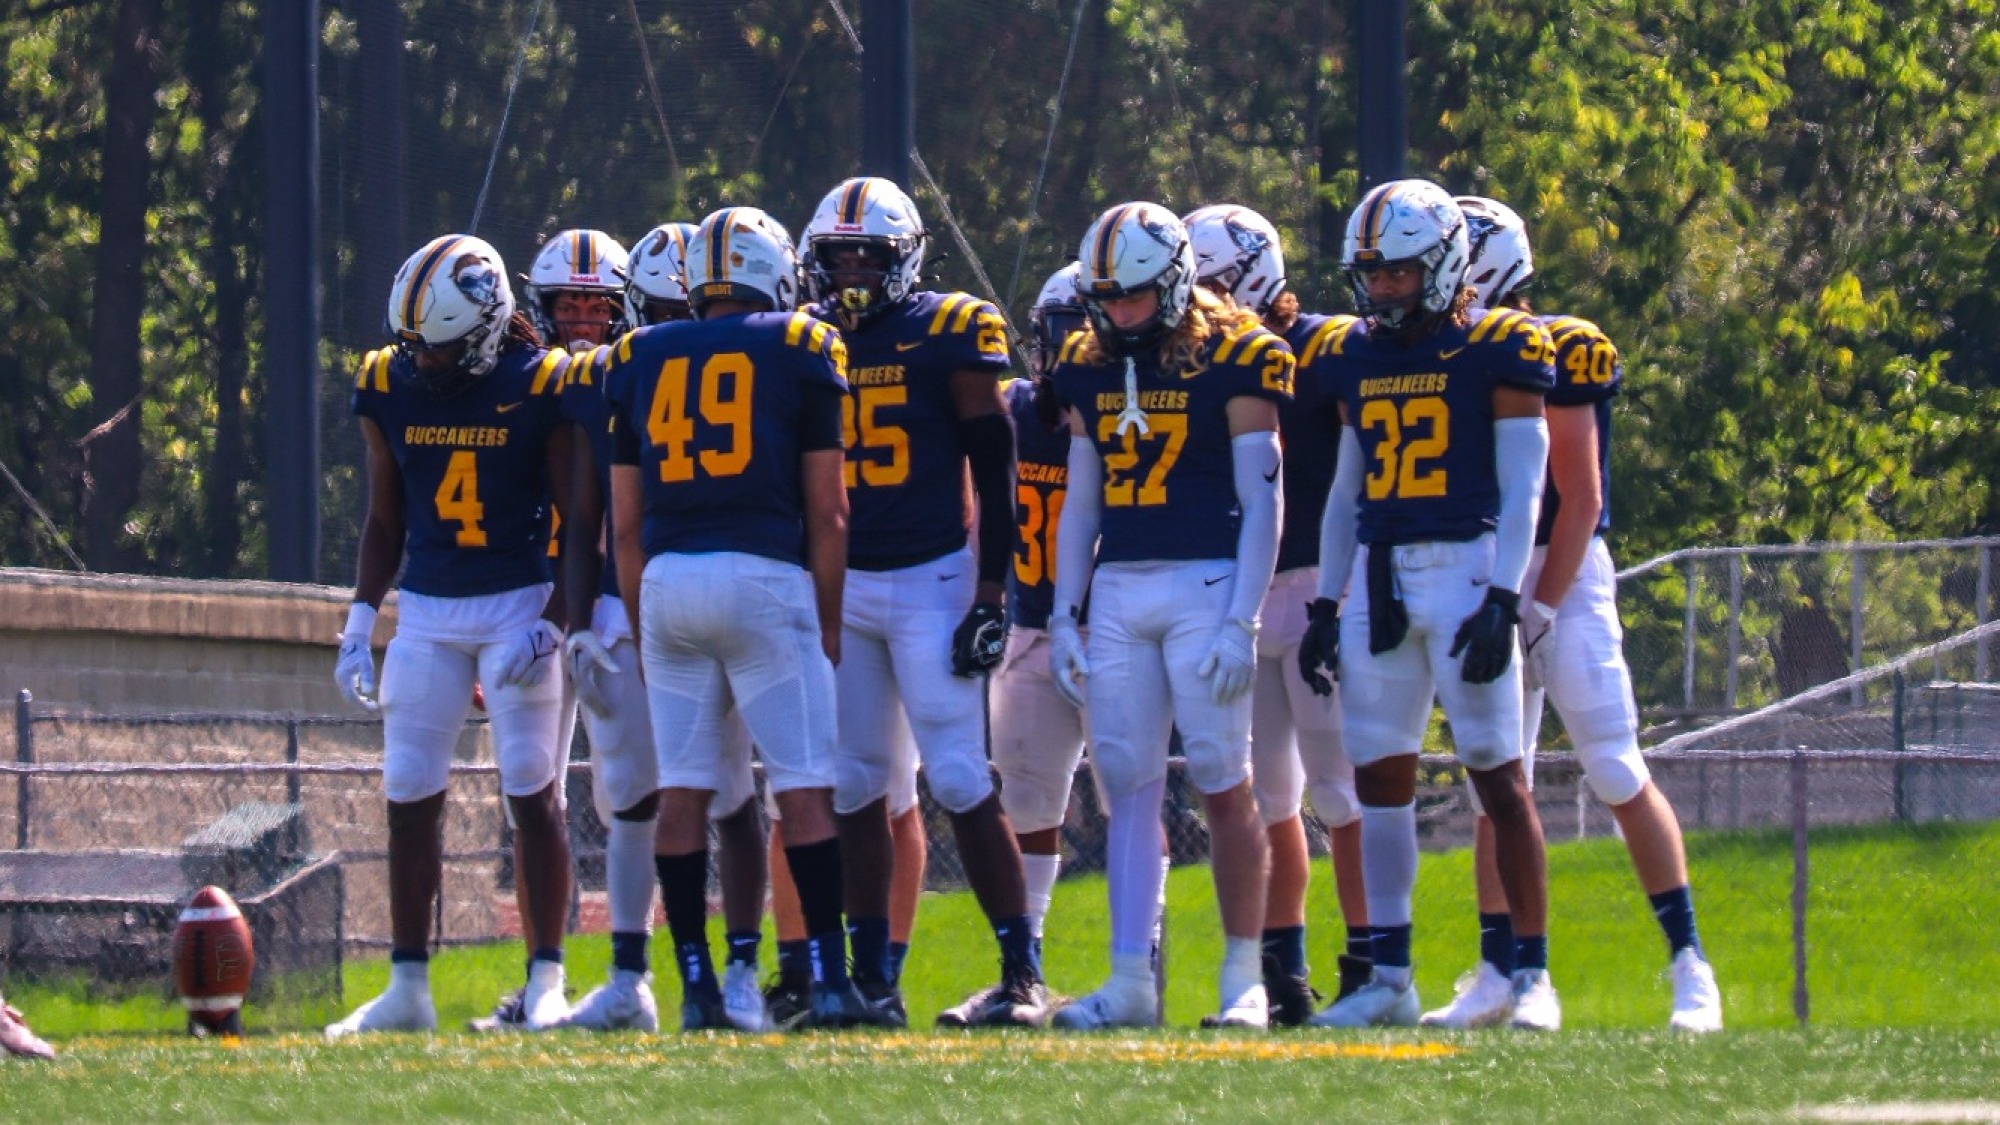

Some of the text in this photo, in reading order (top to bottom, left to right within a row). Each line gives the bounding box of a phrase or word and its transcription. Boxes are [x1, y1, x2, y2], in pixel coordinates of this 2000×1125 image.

[849, 365, 906, 385] ANEERS
[1565, 341, 1614, 384] 40
[1096, 390, 1189, 411] BUCNEERS
[1359, 373, 1448, 396] BUCCANEERS
[404, 425, 509, 446] BUCCANEERS
[647, 353, 754, 483] 49
[1097, 413, 1188, 506] 27
[1360, 396, 1448, 500] 32
[434, 450, 487, 547] 4
